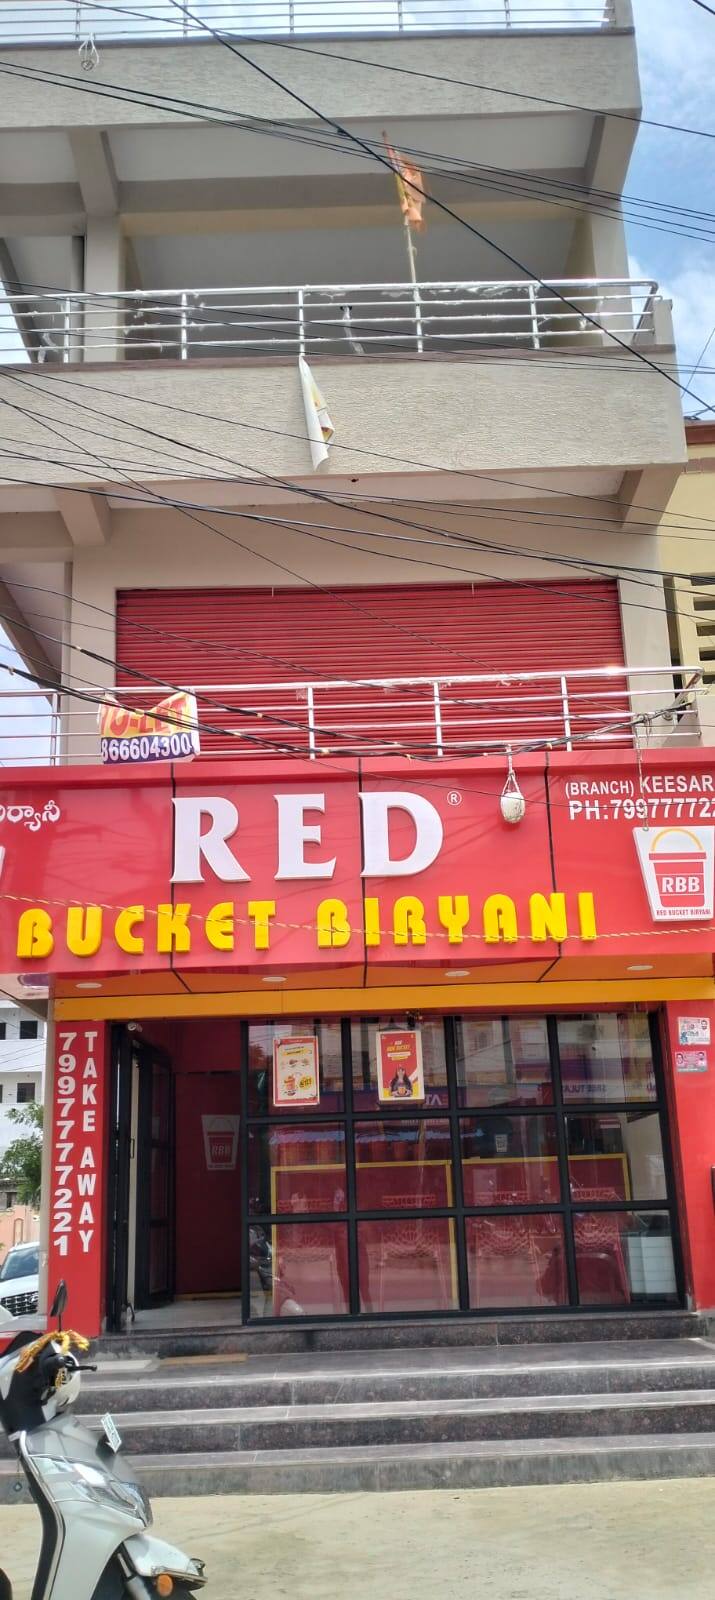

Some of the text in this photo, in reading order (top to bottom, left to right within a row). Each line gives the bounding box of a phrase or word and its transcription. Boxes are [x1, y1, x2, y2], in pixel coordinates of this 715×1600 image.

[565, 780, 634, 799] (BRANCH)
[169, 791, 444, 883] RED
[662, 876, 700, 893] RBB
[16, 892, 598, 959] BUCKET BIRYANI
[52, 1032, 77, 1256] 7997777221
[77, 1031, 98, 1253] TAKE AWAY
